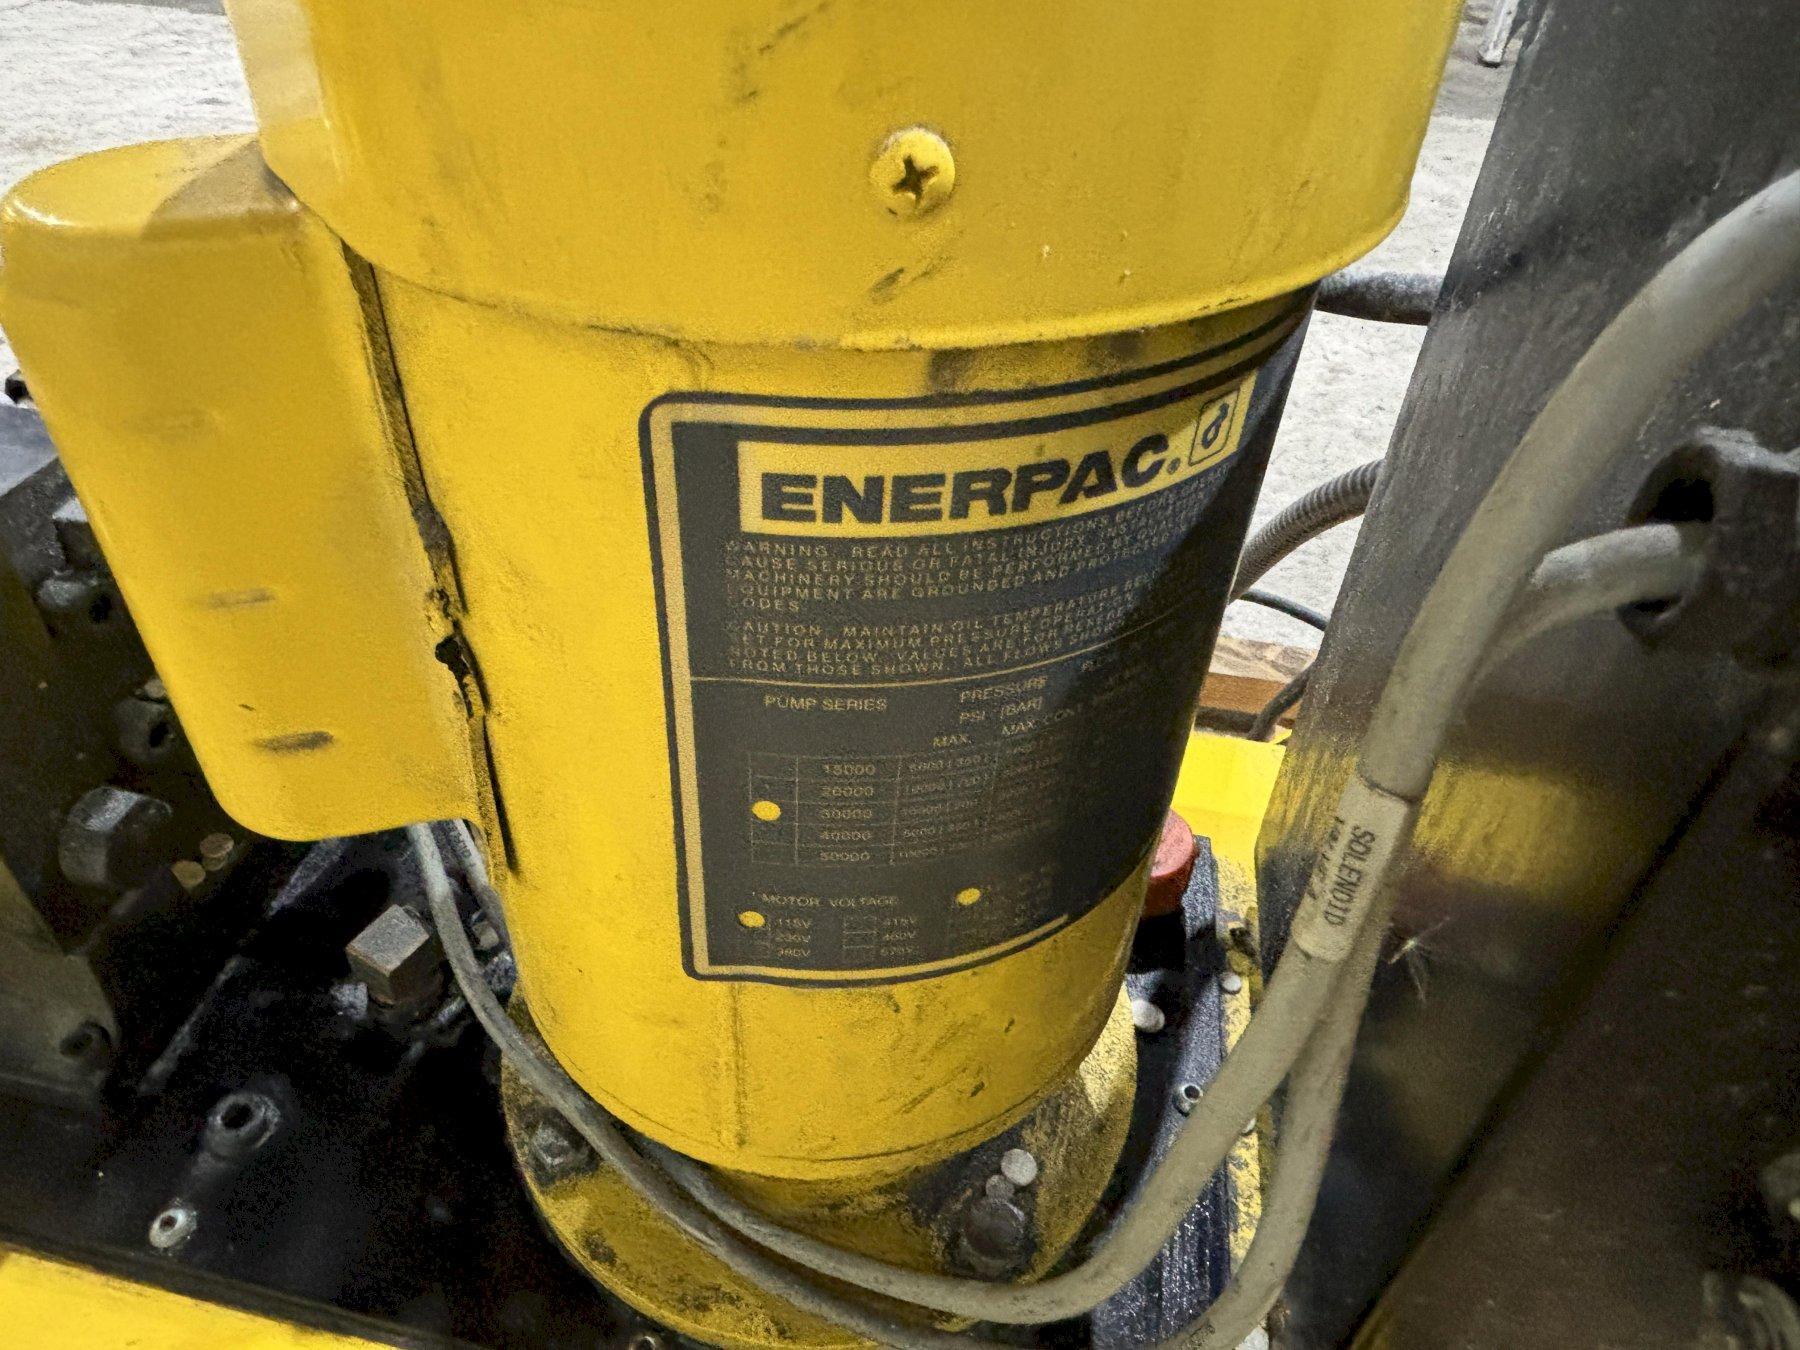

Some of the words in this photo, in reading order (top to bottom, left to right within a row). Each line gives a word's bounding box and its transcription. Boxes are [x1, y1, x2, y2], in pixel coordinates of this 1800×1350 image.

[763, 694, 817, 711] PUMP
[822, 697, 888, 711] SERIES
[1323, 824, 1376, 926] SOLENOID
